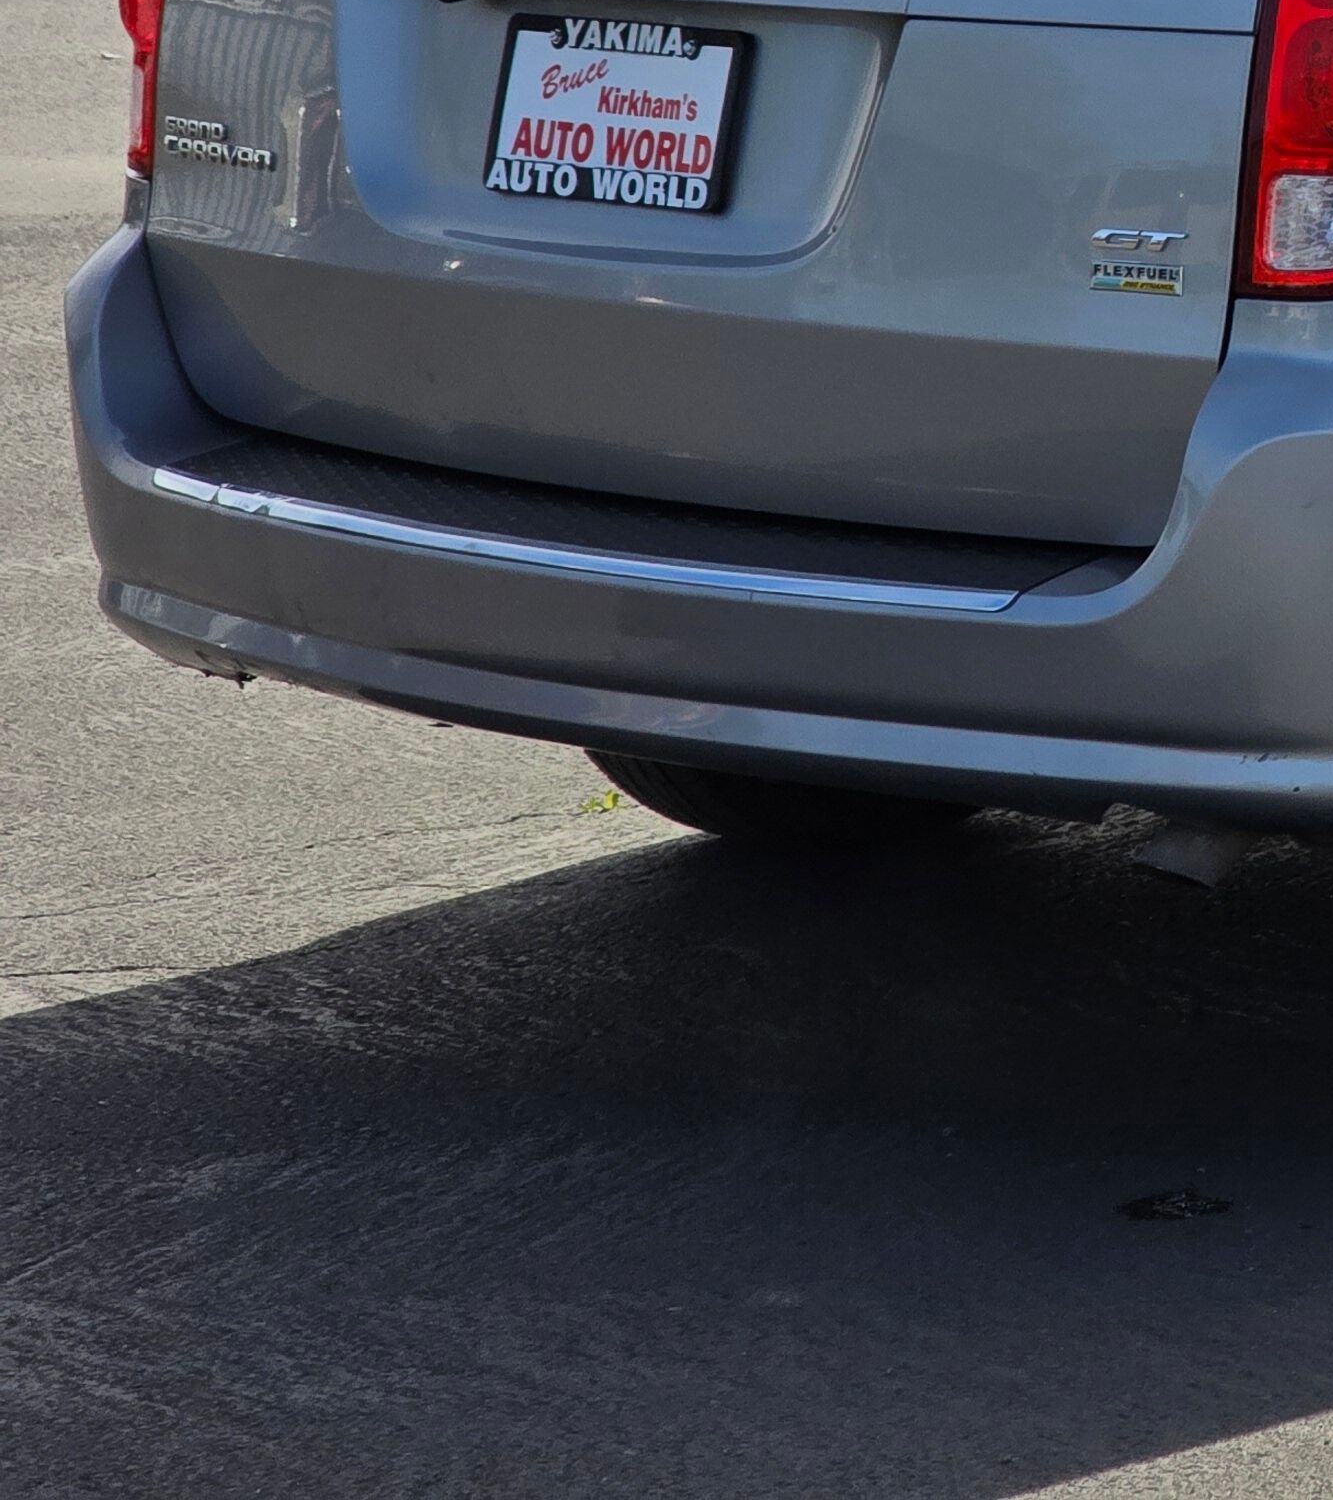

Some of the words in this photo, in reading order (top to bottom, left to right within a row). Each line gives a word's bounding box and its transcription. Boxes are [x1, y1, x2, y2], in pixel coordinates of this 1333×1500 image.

[563, 17, 683, 57] YAKIMA
[541, 58, 609, 100] Bruce
[597, 85, 698, 122] Kirkham's
[164, 115, 225, 139] GRAND
[511, 117, 594, 163] AUTO
[606, 126, 712, 175] WORLD
[485, 159, 578, 197] AUTO
[592, 167, 708, 210] WORLD
[1091, 228, 1187, 251] GT
[1093, 263, 1178, 281] FLEXFUEL
